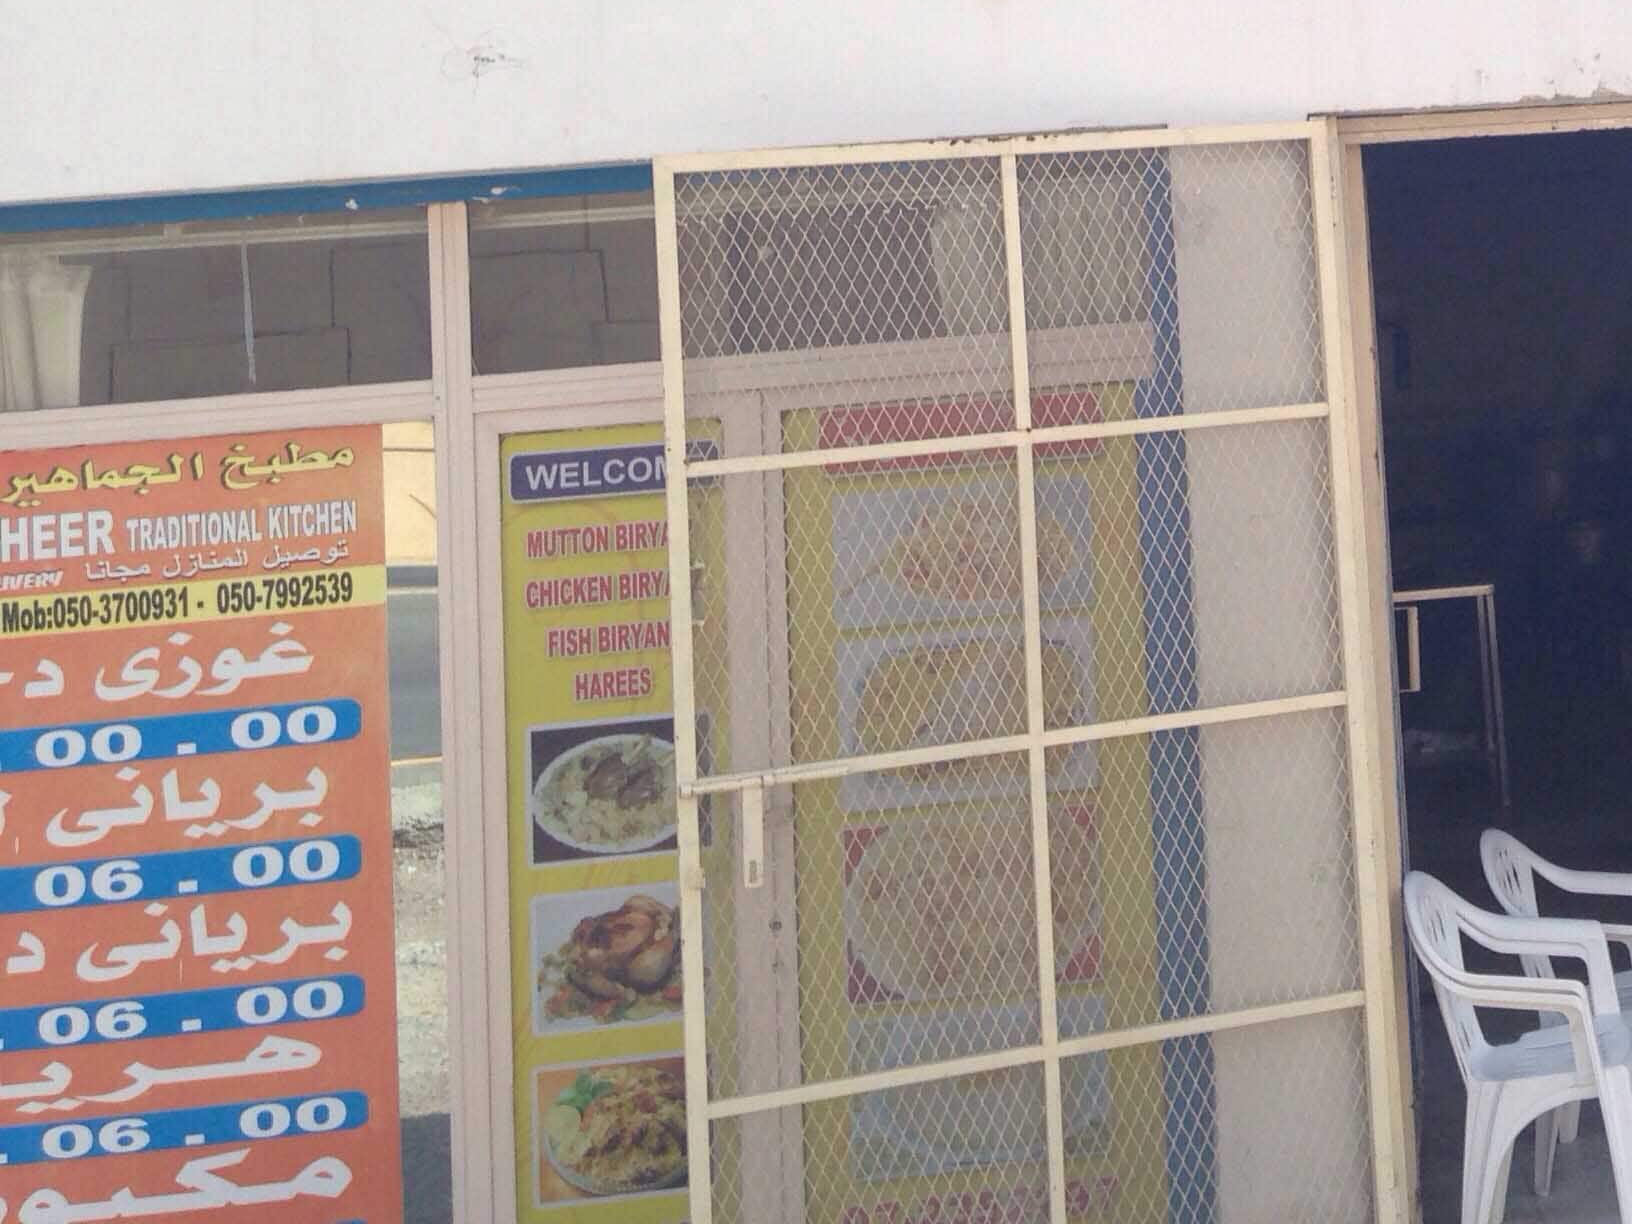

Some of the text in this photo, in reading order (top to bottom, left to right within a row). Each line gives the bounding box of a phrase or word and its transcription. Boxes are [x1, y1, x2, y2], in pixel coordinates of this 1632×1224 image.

[0, 441, 355, 508] مطبخ الجماهير
[126, 509, 263, 553] TRADITIONAL
[268, 500, 357, 540] KITCHEN
[527, 526, 608, 558] MUTTON
[162, 548, 249, 579] المنازل
[263, 538, 351, 570] توصيل
[216, 571, 353, 614] 050-7992539
[526, 576, 612, 609] CHICKEN
[548, 628, 592, 657] FISH
[575, 667, 652, 700] HAREES
